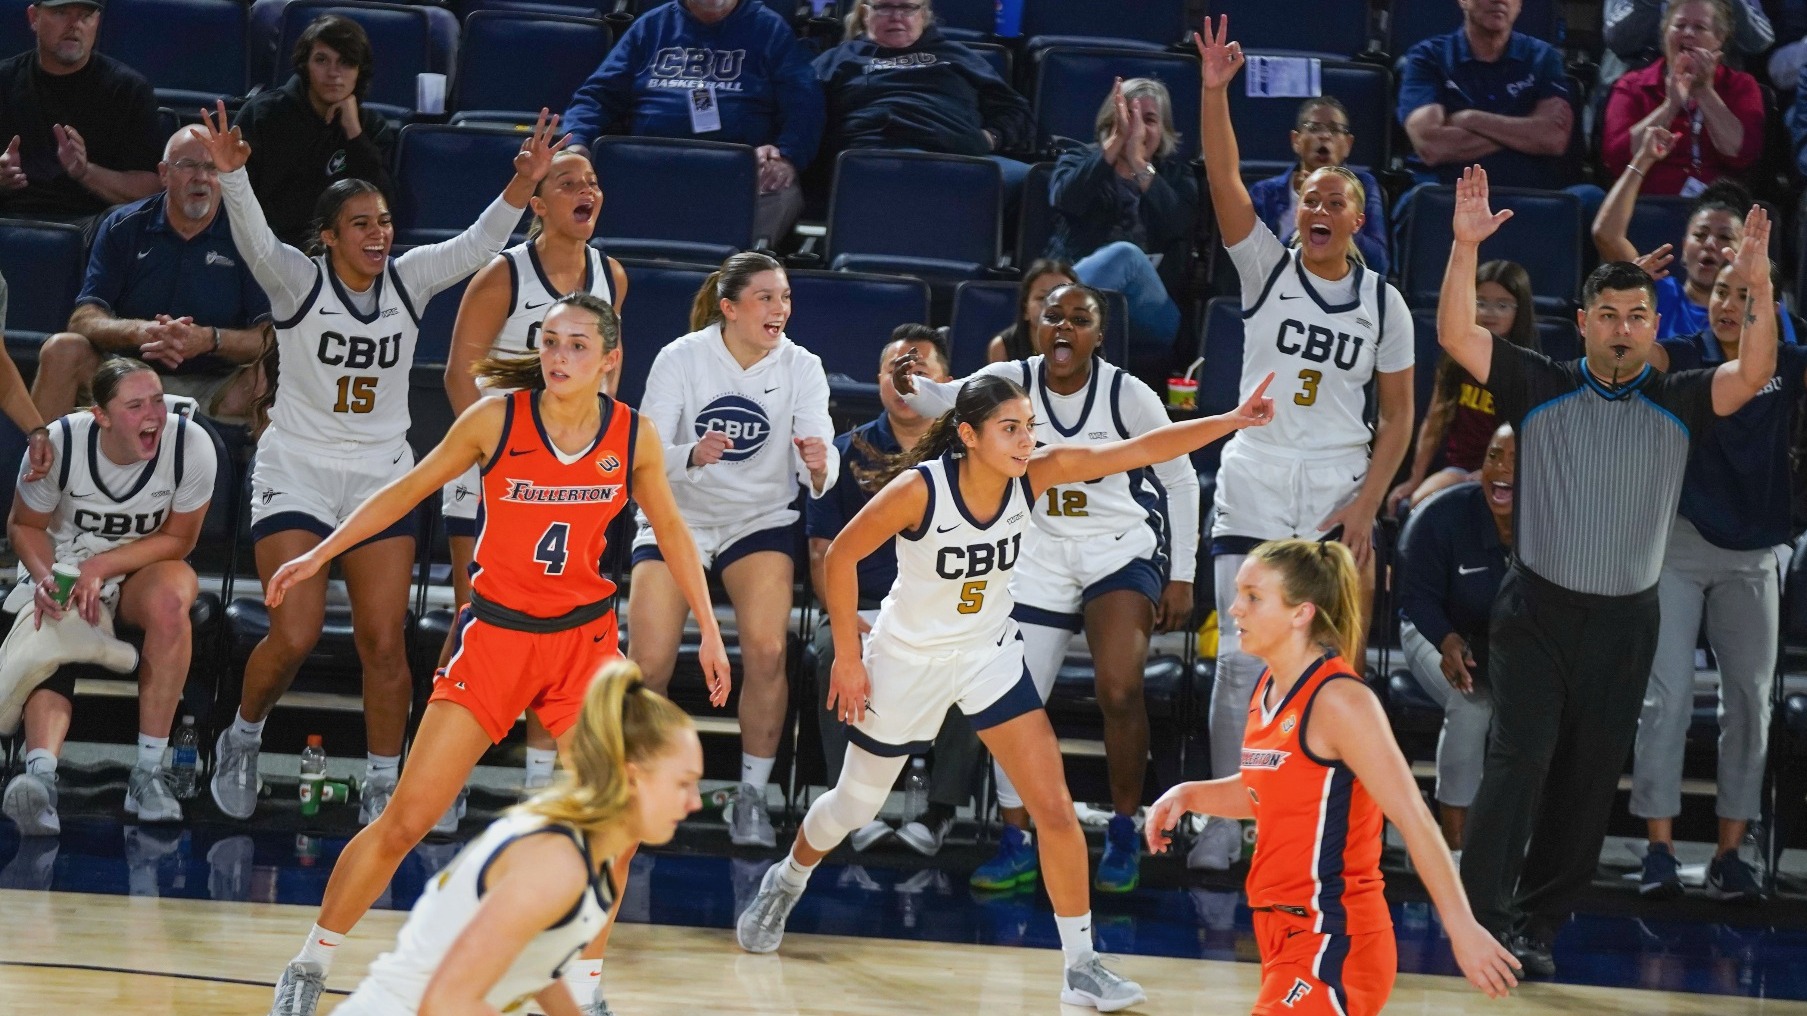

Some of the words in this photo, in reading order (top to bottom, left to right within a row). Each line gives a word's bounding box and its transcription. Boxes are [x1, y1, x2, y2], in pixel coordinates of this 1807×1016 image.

[653, 46, 746, 81] CBU
[648, 78, 744, 92] BASKEBALL
[317, 331, 402, 369] CBU
[1276, 318, 1364, 371] CBU
[333, 375, 379, 413] 15
[1293, 368, 1323, 406] 3
[707, 418, 762, 440] CBU
[511, 482, 612, 501] FULLERTON
[1046, 487, 1089, 517] 12
[74, 508, 165, 536] CBU
[533, 521, 571, 575] 4
[936, 532, 1022, 580] CBU
[957, 580, 988, 614] 5
[1281, 977, 1313, 1008] F
